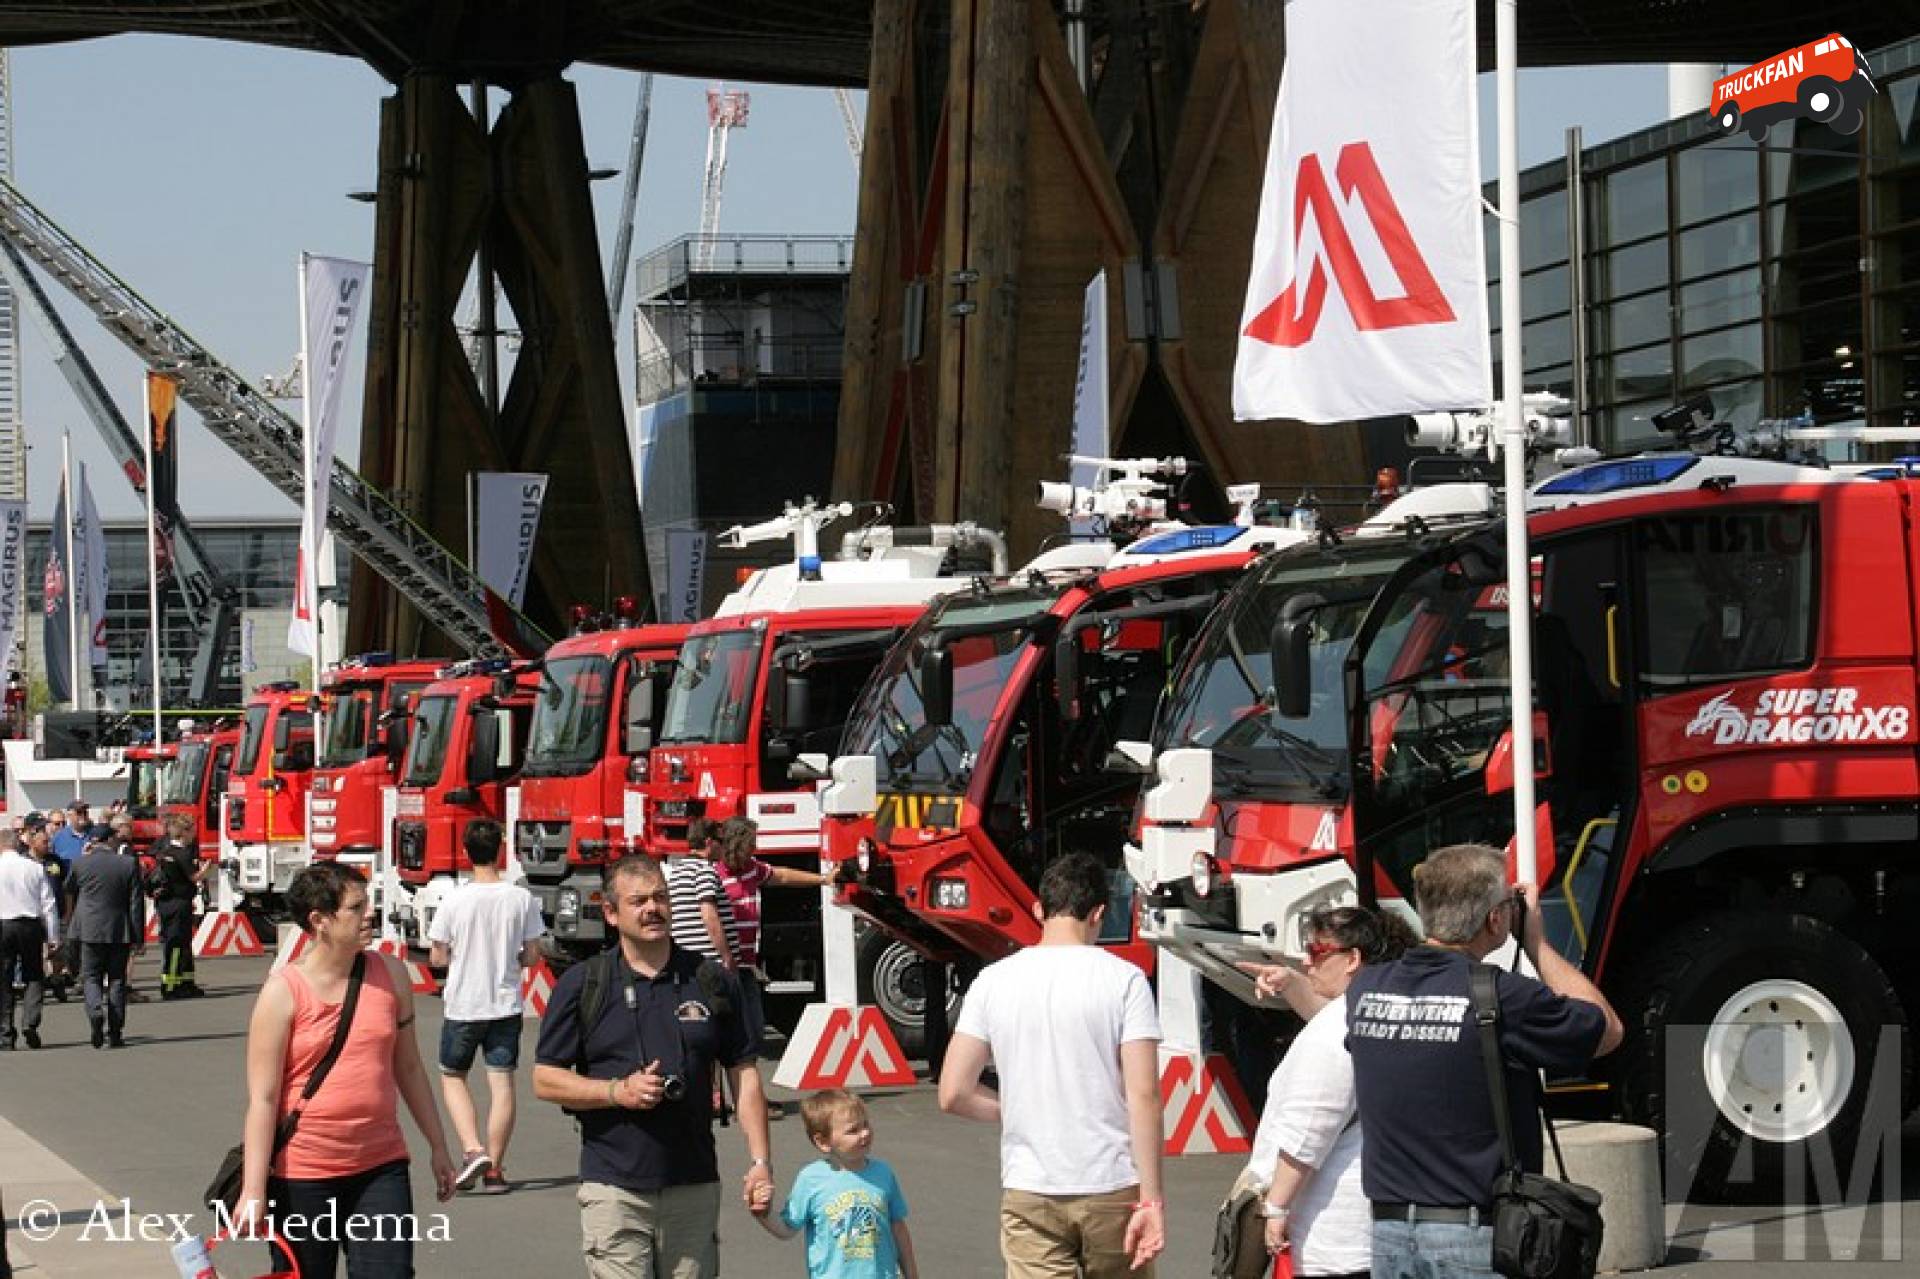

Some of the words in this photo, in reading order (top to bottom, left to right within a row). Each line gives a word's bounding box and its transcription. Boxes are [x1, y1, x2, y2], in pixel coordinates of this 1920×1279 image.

[1, 510, 22, 632] MAGIRUS
[683, 536, 703, 622] AGIRUS
[1755, 688, 1858, 715] SUPER
